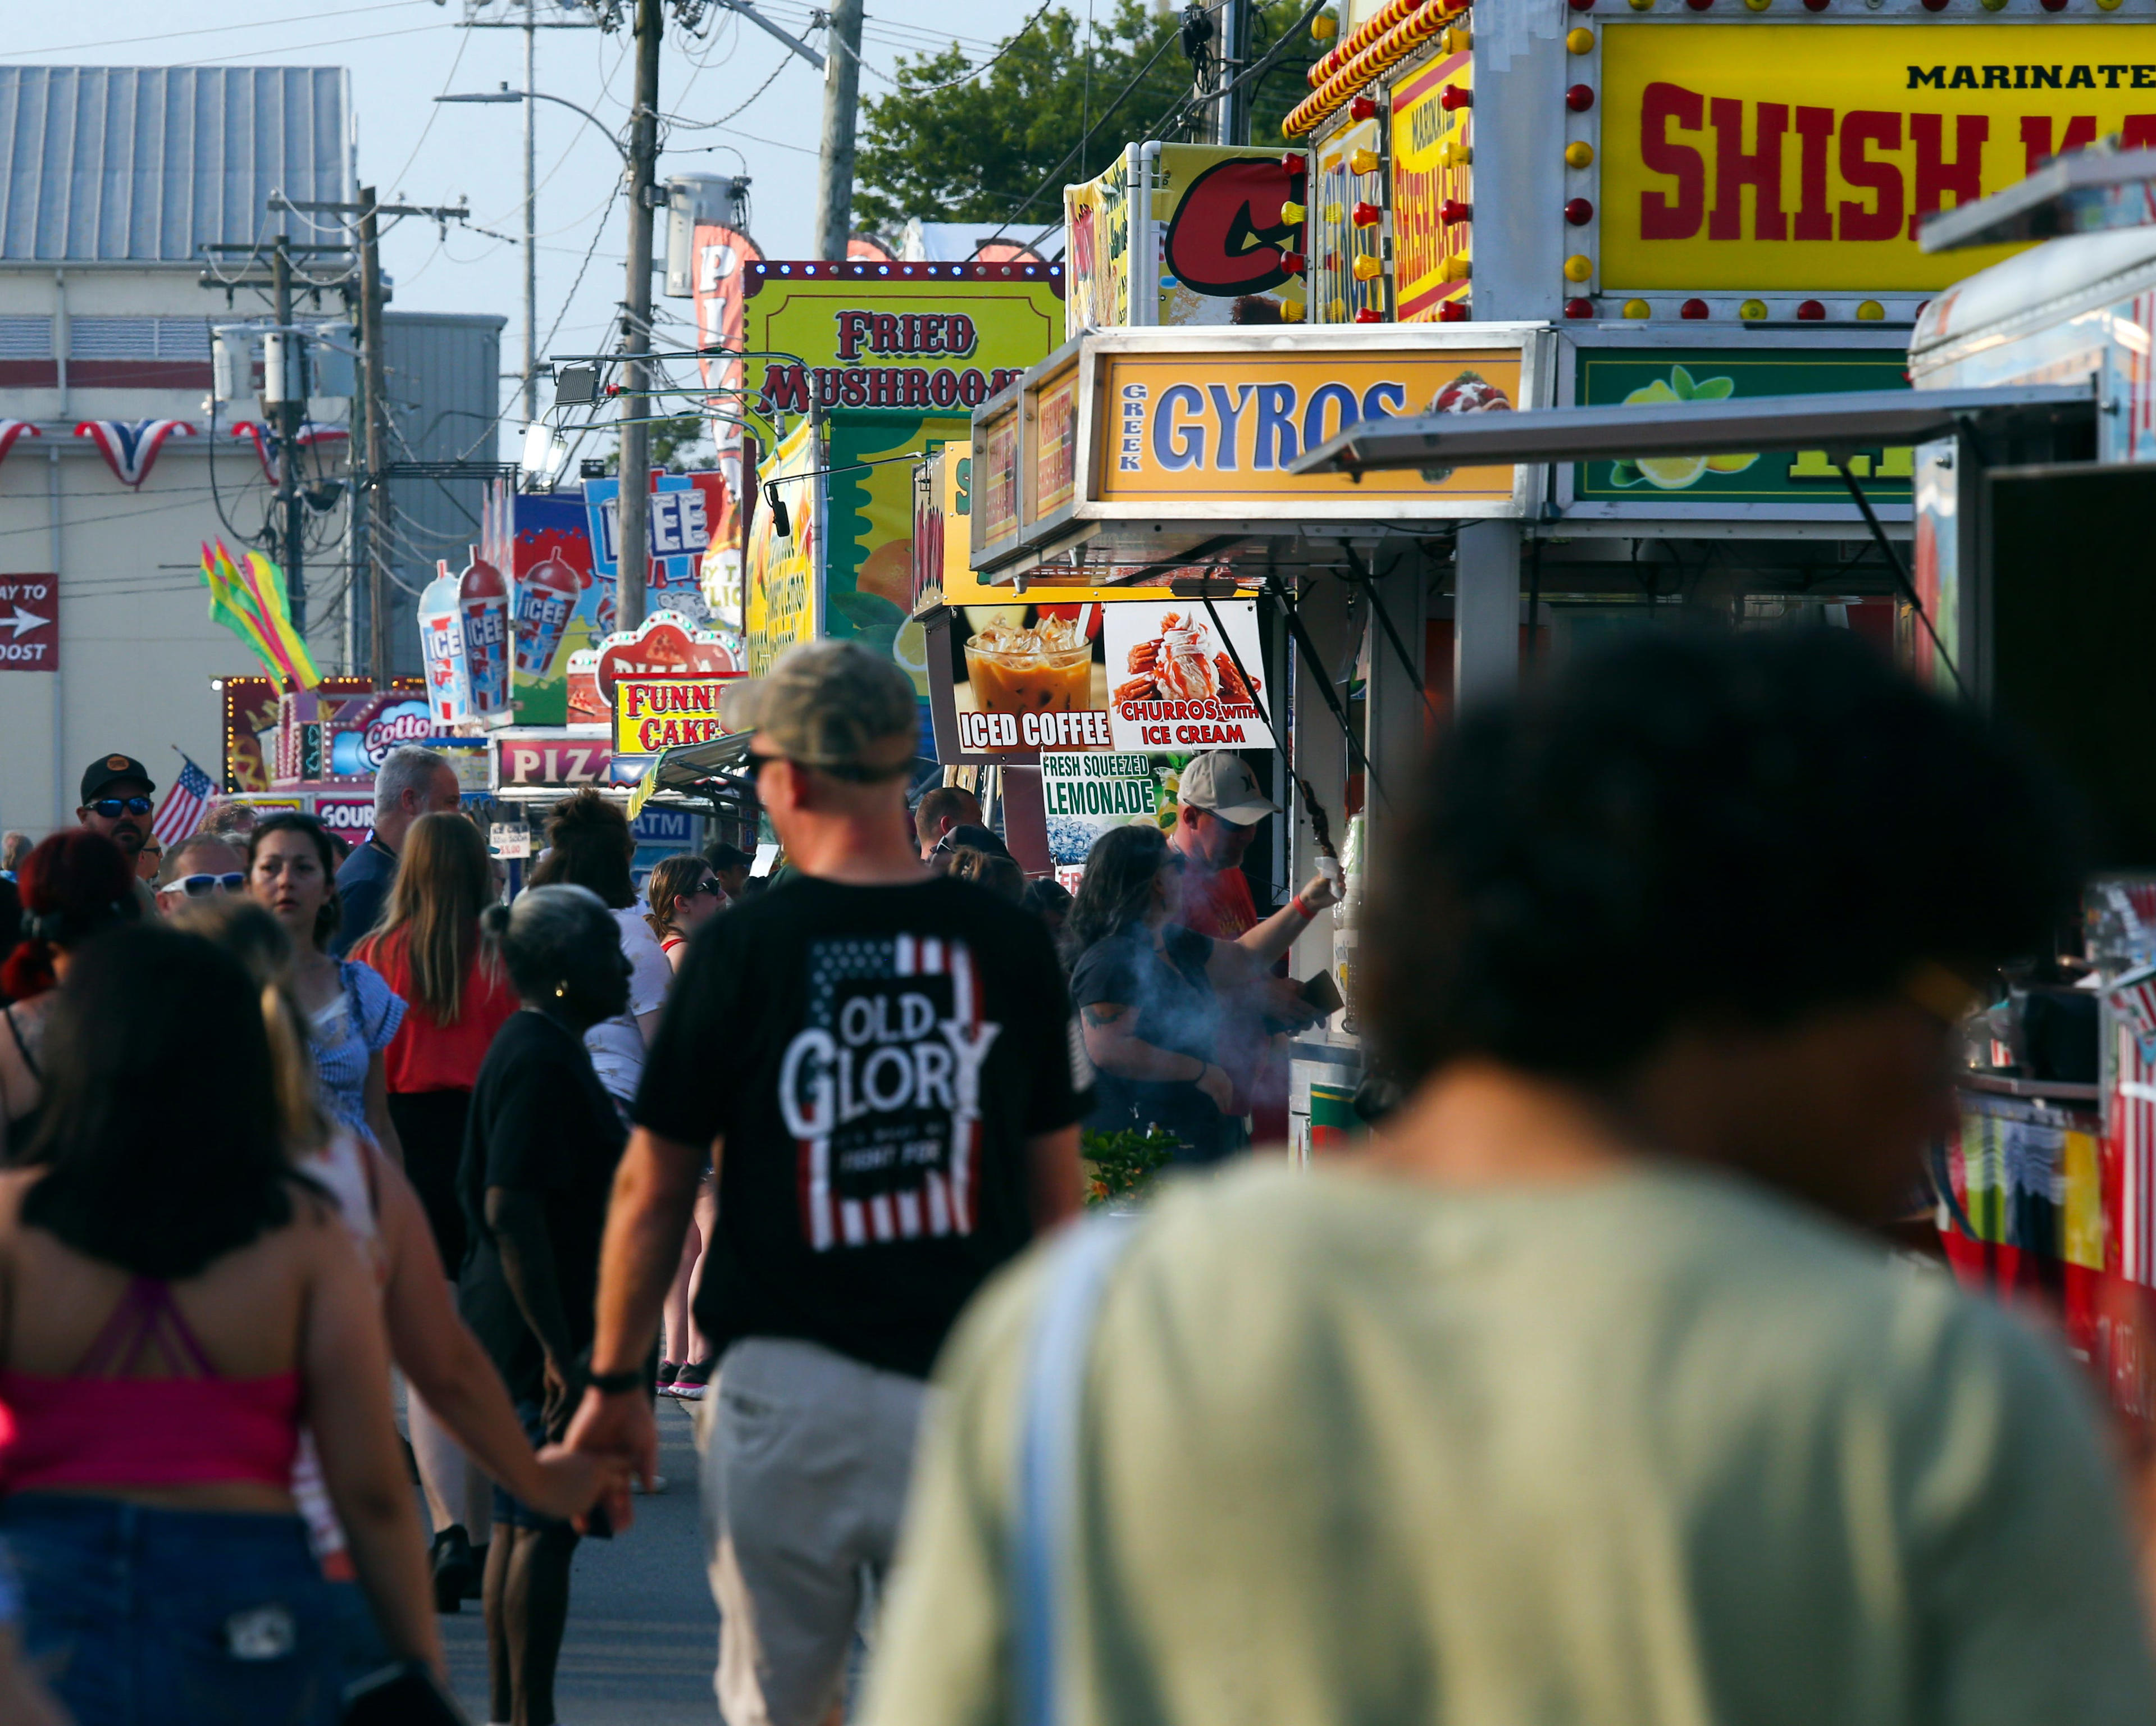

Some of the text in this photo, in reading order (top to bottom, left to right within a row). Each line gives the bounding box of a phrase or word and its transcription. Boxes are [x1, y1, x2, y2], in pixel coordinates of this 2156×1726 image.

[835, 311, 978, 359] FRIED
[1120, 384, 1147, 472] GREEK
[23, 584, 47, 600] TO
[1121, 701, 1259, 722] CHURROS WITH
[960, 712, 1111, 748] ICED COFFEE
[1142, 725, 1246, 744] ICE CREAM
[1043, 755, 1149, 778] FRESH SQUEEZED
[1046, 780, 1156, 814] LEMONADE
[840, 992, 935, 1047] OLD
[778, 1019, 1002, 1139] GLORY
